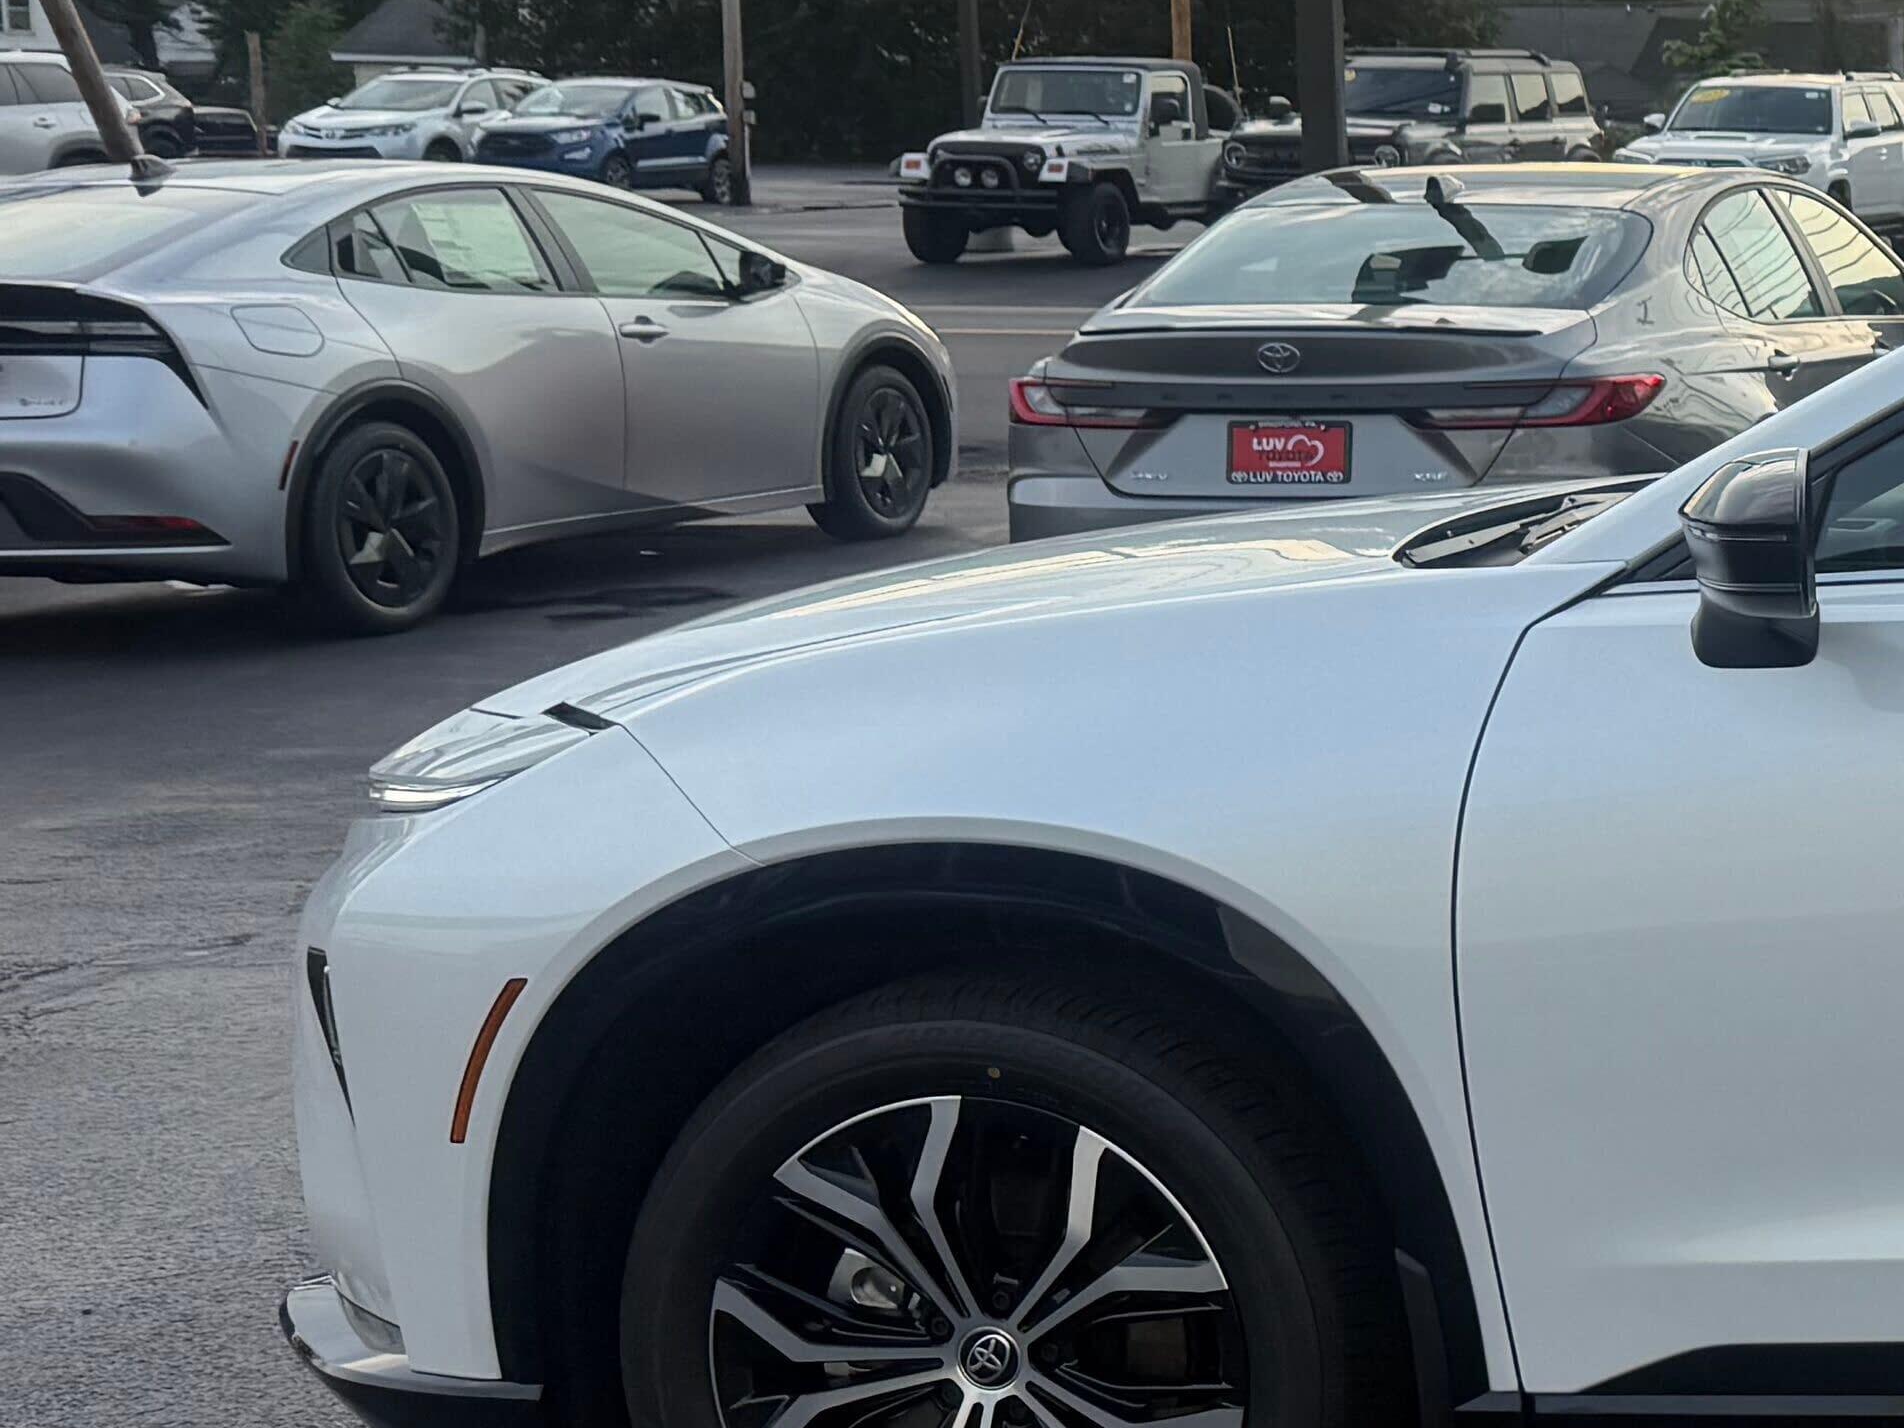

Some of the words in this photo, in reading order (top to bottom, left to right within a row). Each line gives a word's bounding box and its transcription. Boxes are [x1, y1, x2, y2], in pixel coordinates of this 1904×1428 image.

[1252, 437, 1286, 451] LUV
[1249, 471, 1273, 482] LUV
[1277, 471, 1324, 482] TOYOTA
